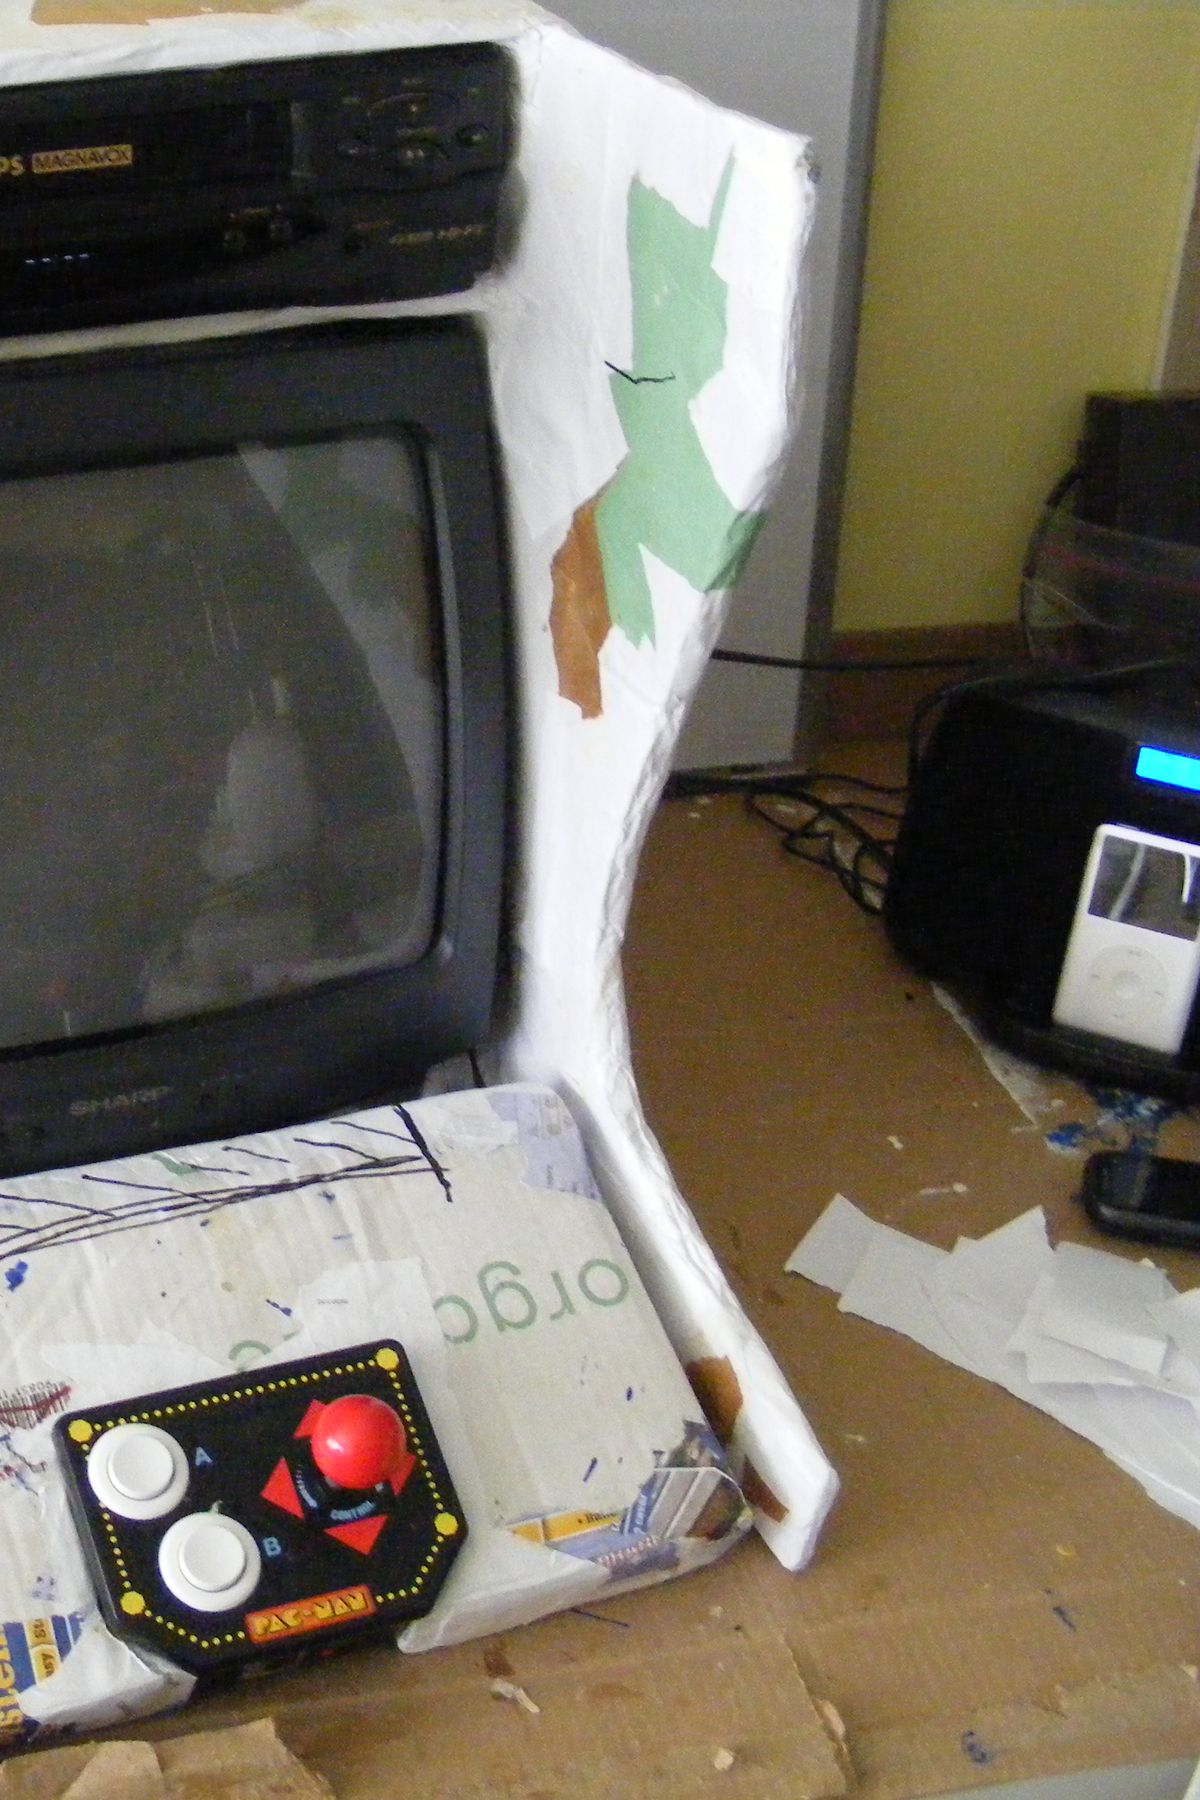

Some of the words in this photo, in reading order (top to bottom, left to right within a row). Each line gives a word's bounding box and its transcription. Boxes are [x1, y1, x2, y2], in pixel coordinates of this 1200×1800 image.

[33, 144, 131, 171] MAGNAVOX
[195, 1447, 212, 1467] A
[263, 1537, 281, 1557] B
[253, 1590, 368, 1635] PAC-MAN
